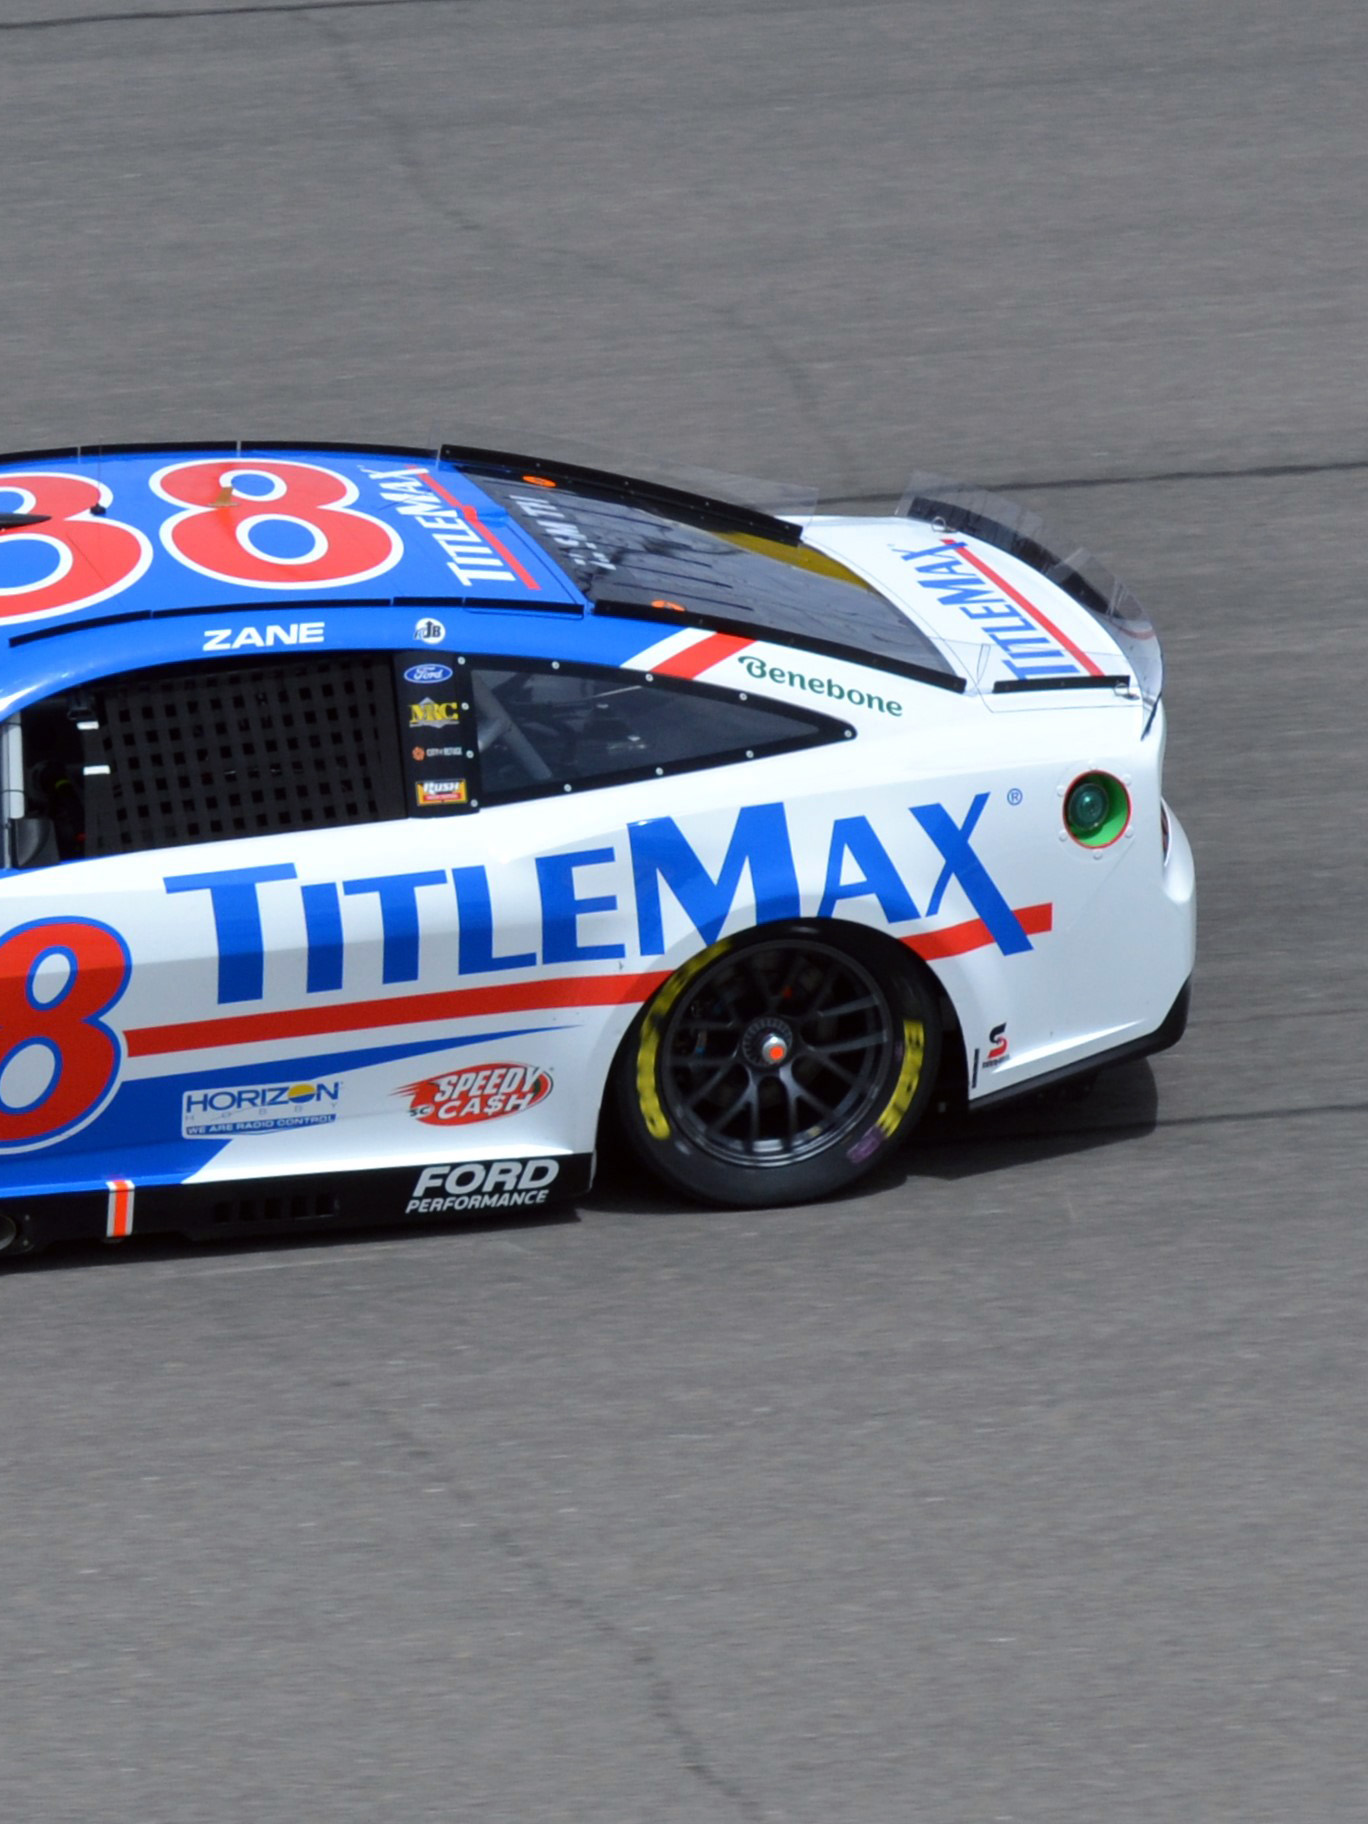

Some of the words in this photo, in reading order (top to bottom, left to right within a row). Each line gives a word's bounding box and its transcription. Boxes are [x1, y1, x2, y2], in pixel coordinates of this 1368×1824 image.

[359, 467, 516, 587] TITLEMAX
[891, 541, 1081, 680] TITLEMAX
[203, 622, 325, 652] ZANE
[413, 667, 443, 681] Ford
[738, 655, 903, 717] Benebone
[162, 791, 1034, 1005] TITLEMAX
[186, 1081, 340, 1113] HORIZON
[433, 1066, 541, 1103] SPEEDY
[188, 1125, 207, 1135] WE
[209, 1122, 234, 1133] ARE
[235, 1119, 274, 1131] RADIO
[276, 1114, 335, 1128] CONTROL
[412, 1159, 559, 1197] FORD
[405, 1188, 549, 1215] PERFORMANCE
